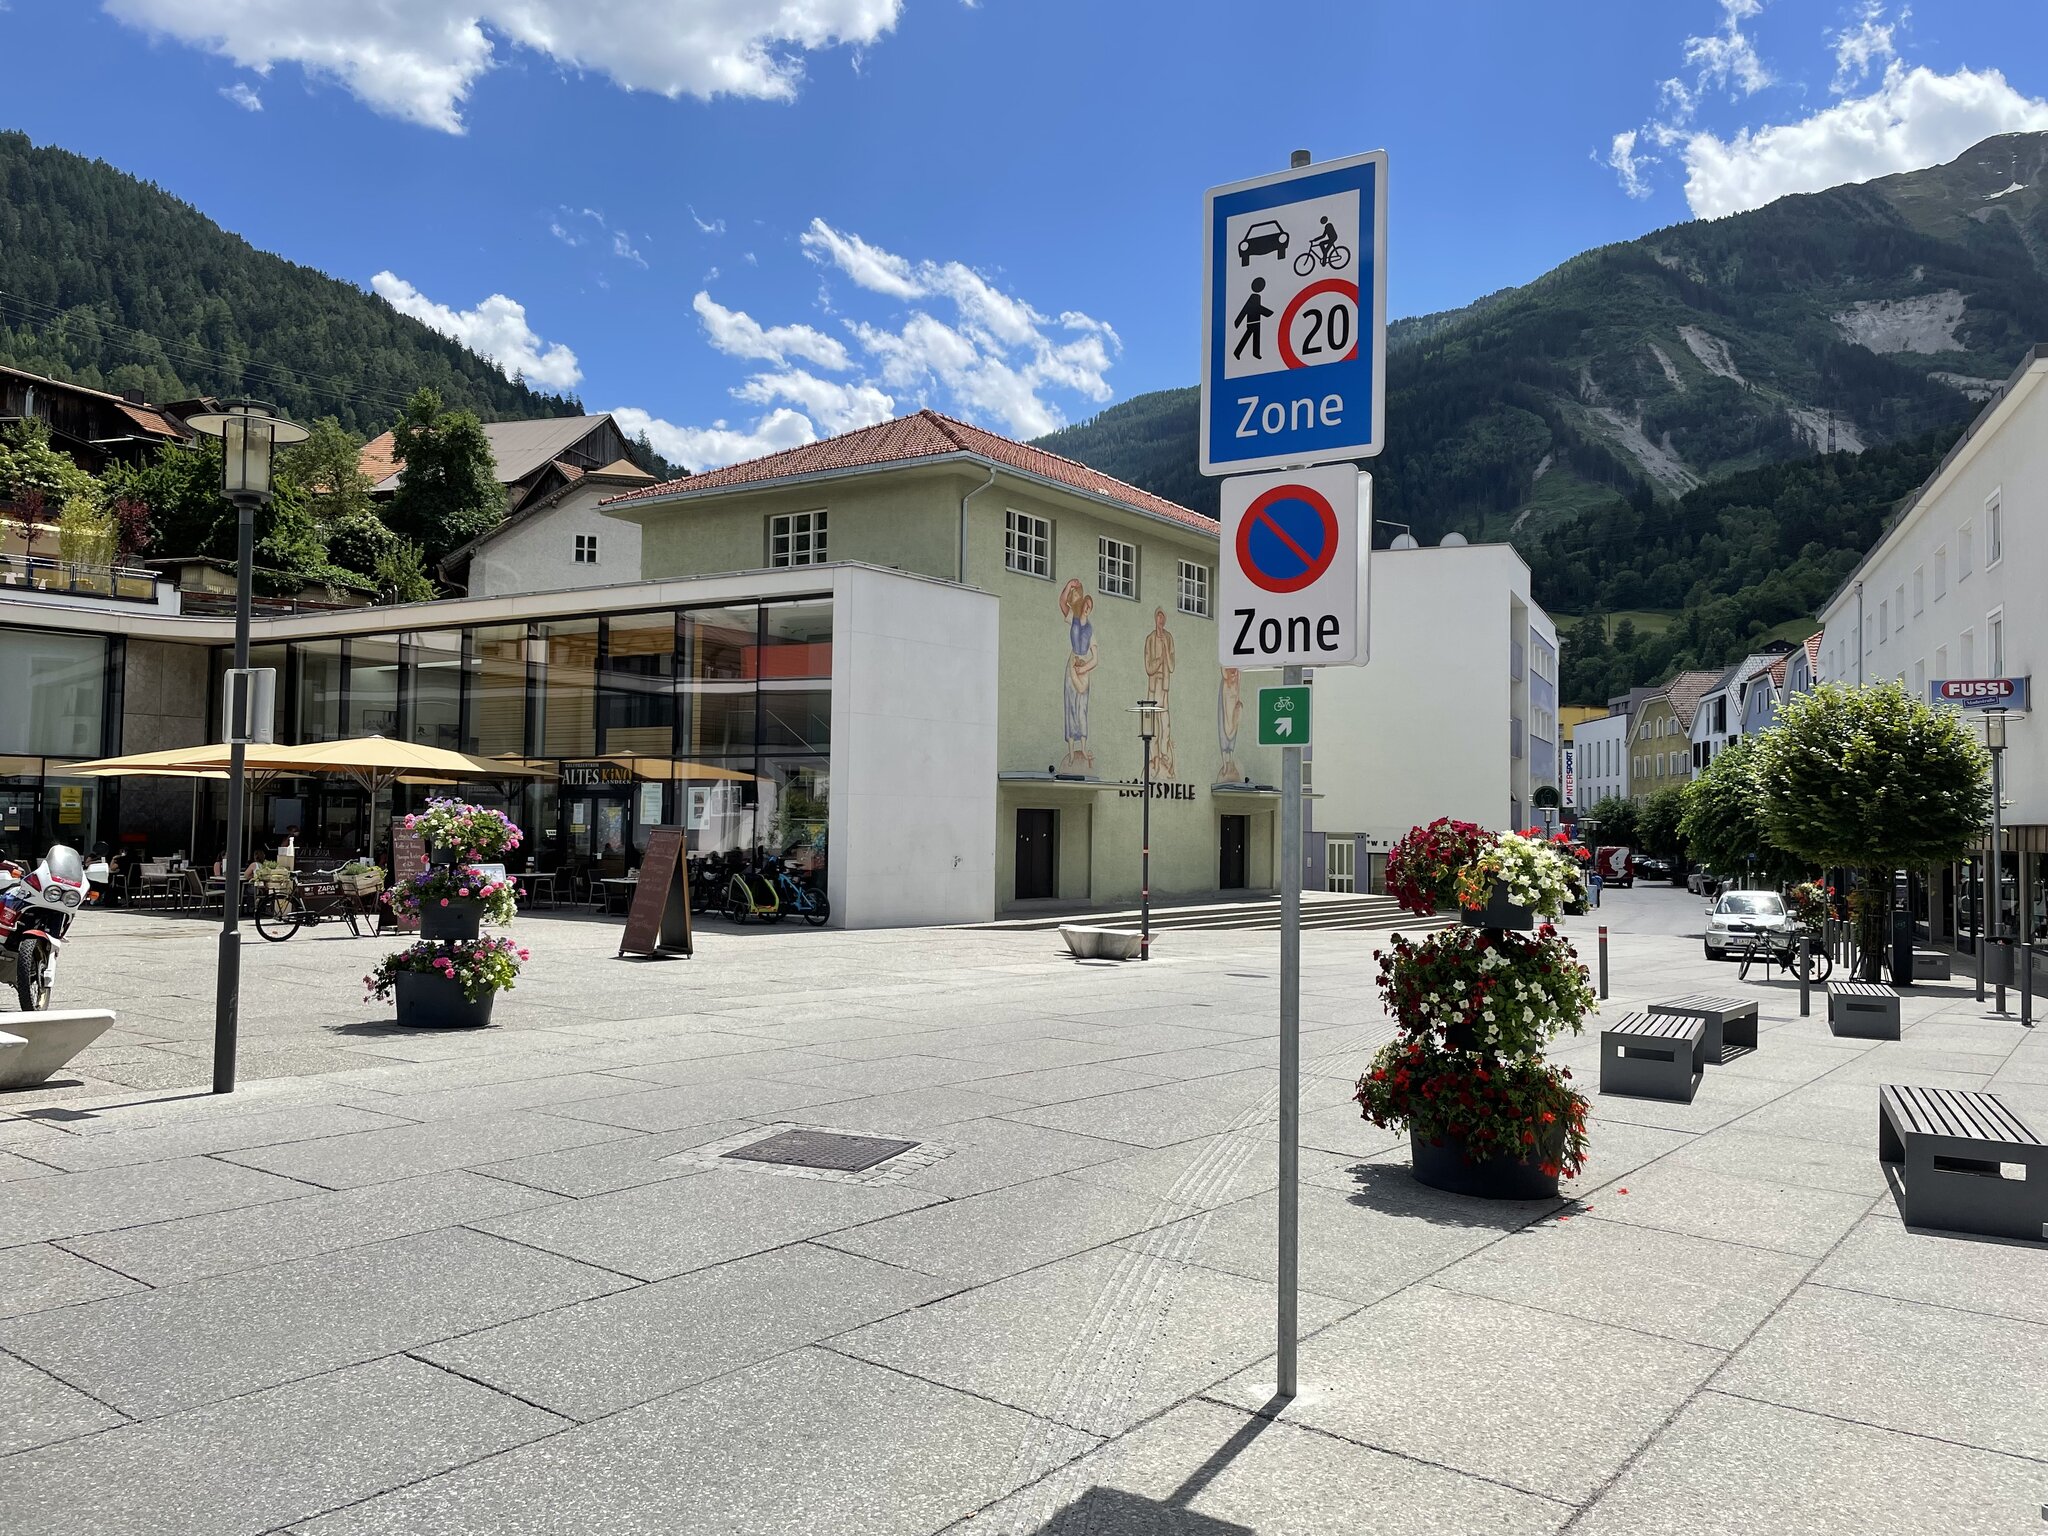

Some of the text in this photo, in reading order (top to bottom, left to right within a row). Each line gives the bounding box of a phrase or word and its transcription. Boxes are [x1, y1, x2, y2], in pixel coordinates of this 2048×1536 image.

[1302, 303, 1350, 356] 20
[1235, 393, 1344, 439] Zone
[1232, 608, 1340, 656] Zone
[1948, 682, 2010, 697] FUSSL
[562, 768, 600, 785] ALTES
[1566, 751, 1574, 797] INTERSPORT
